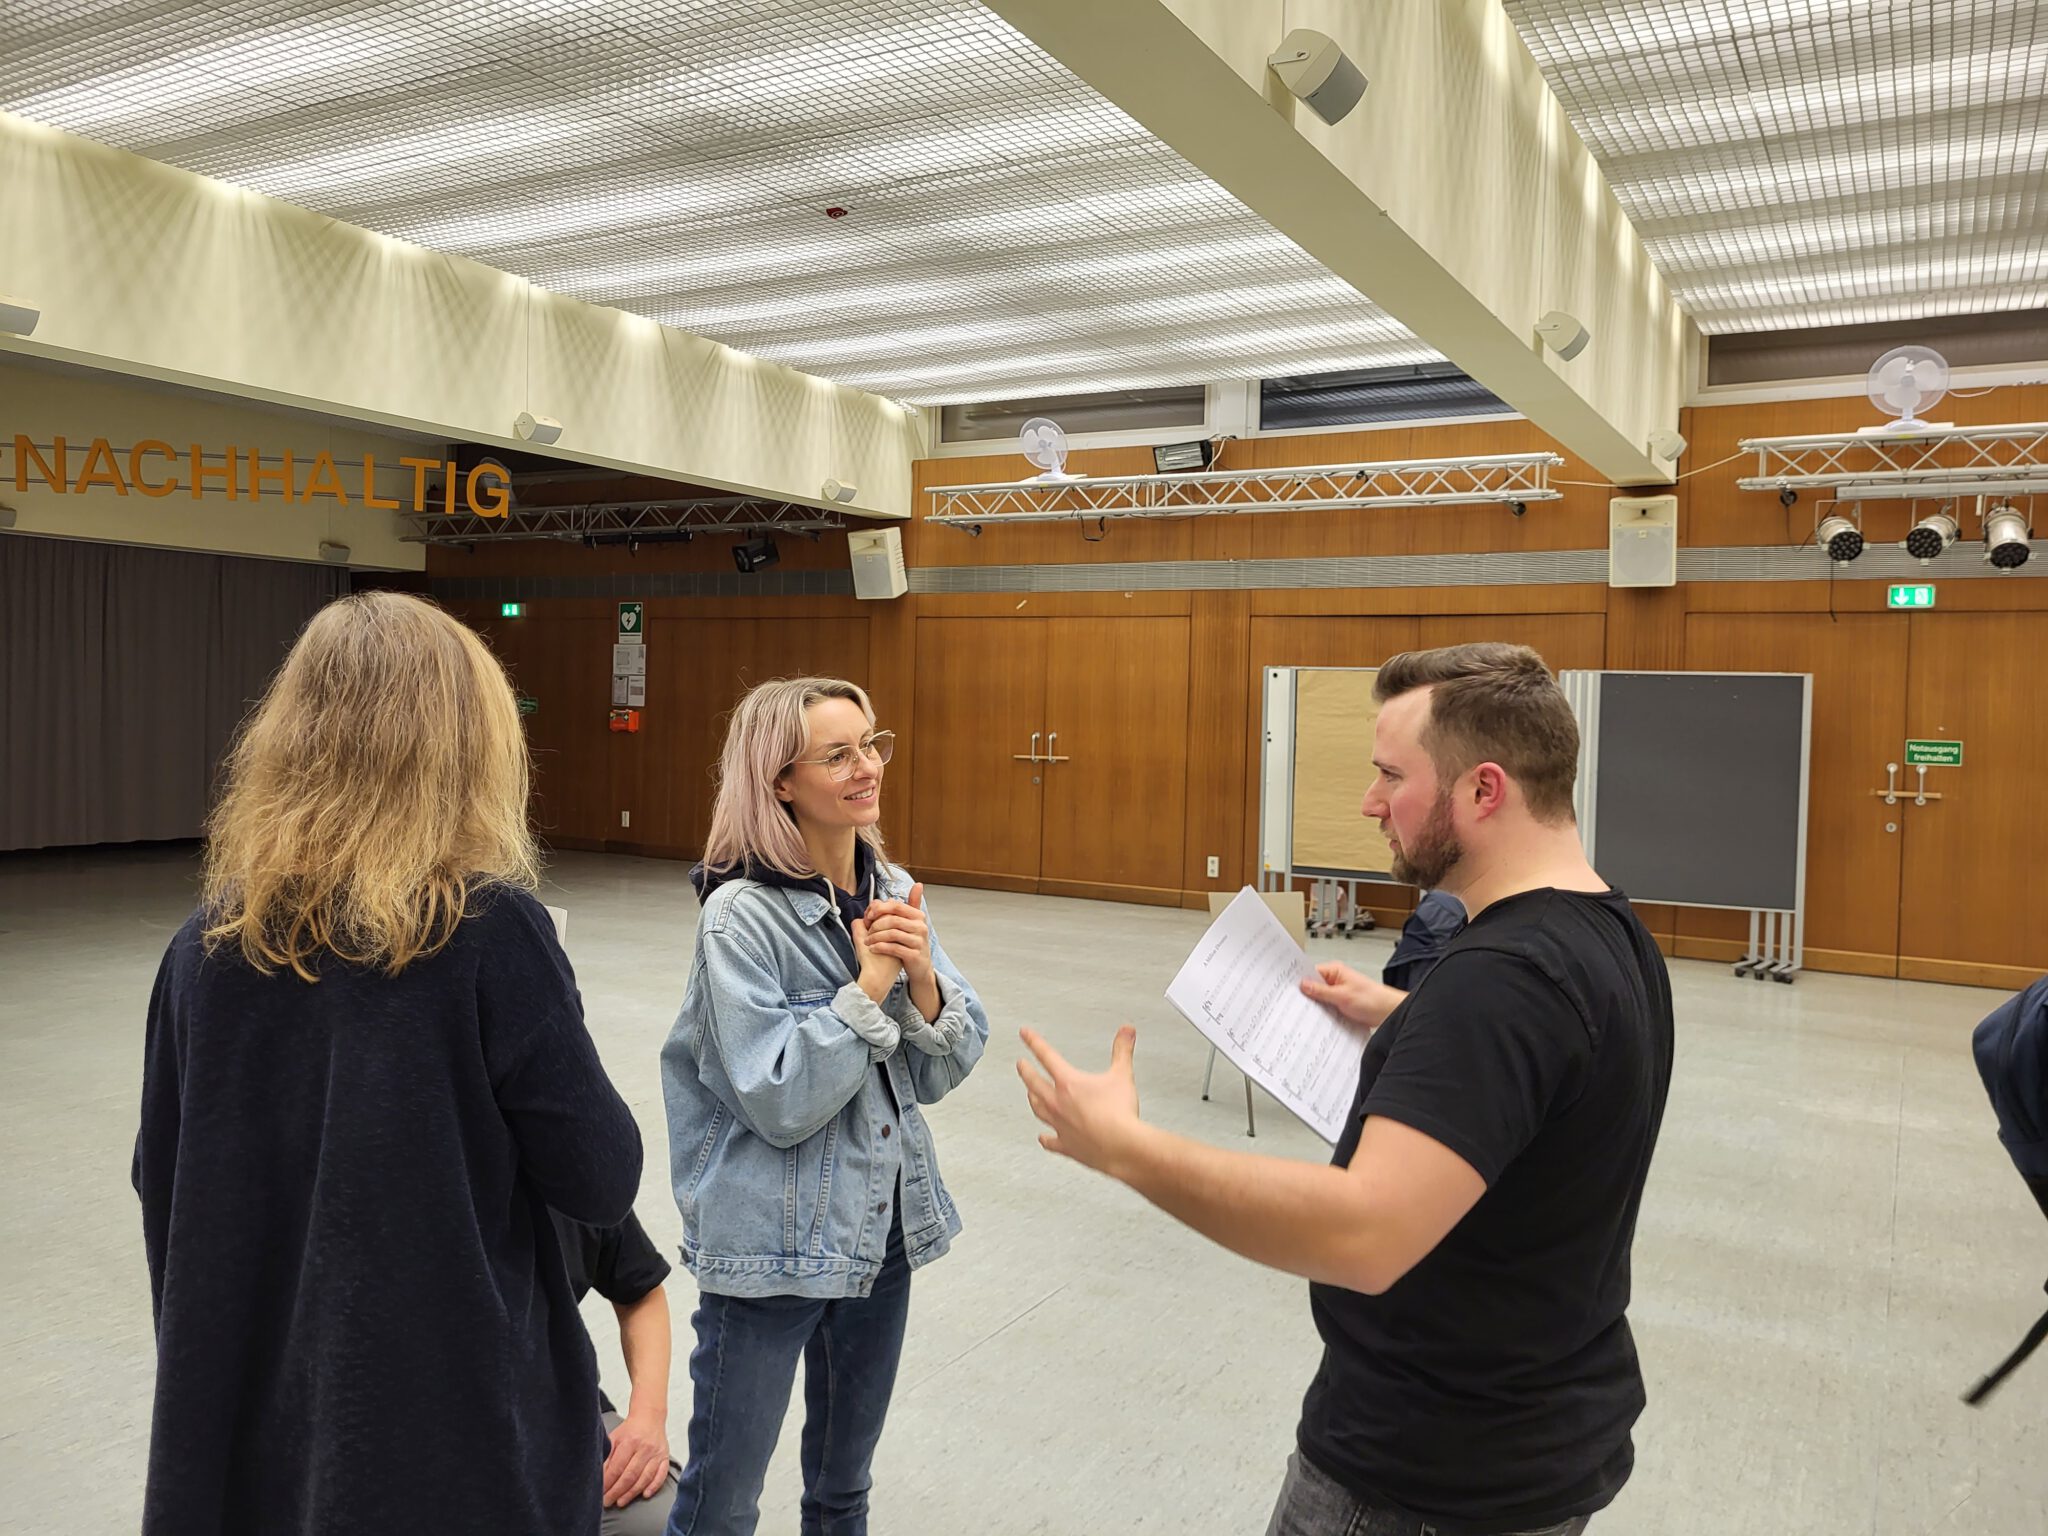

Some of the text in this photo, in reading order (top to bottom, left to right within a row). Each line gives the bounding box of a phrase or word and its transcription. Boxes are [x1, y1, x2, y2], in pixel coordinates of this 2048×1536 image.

[14, 434, 510, 518] NACHHALTIG
[1909, 744, 1959, 755] Notausgang
[1913, 753, 1953, 762] freihalten
